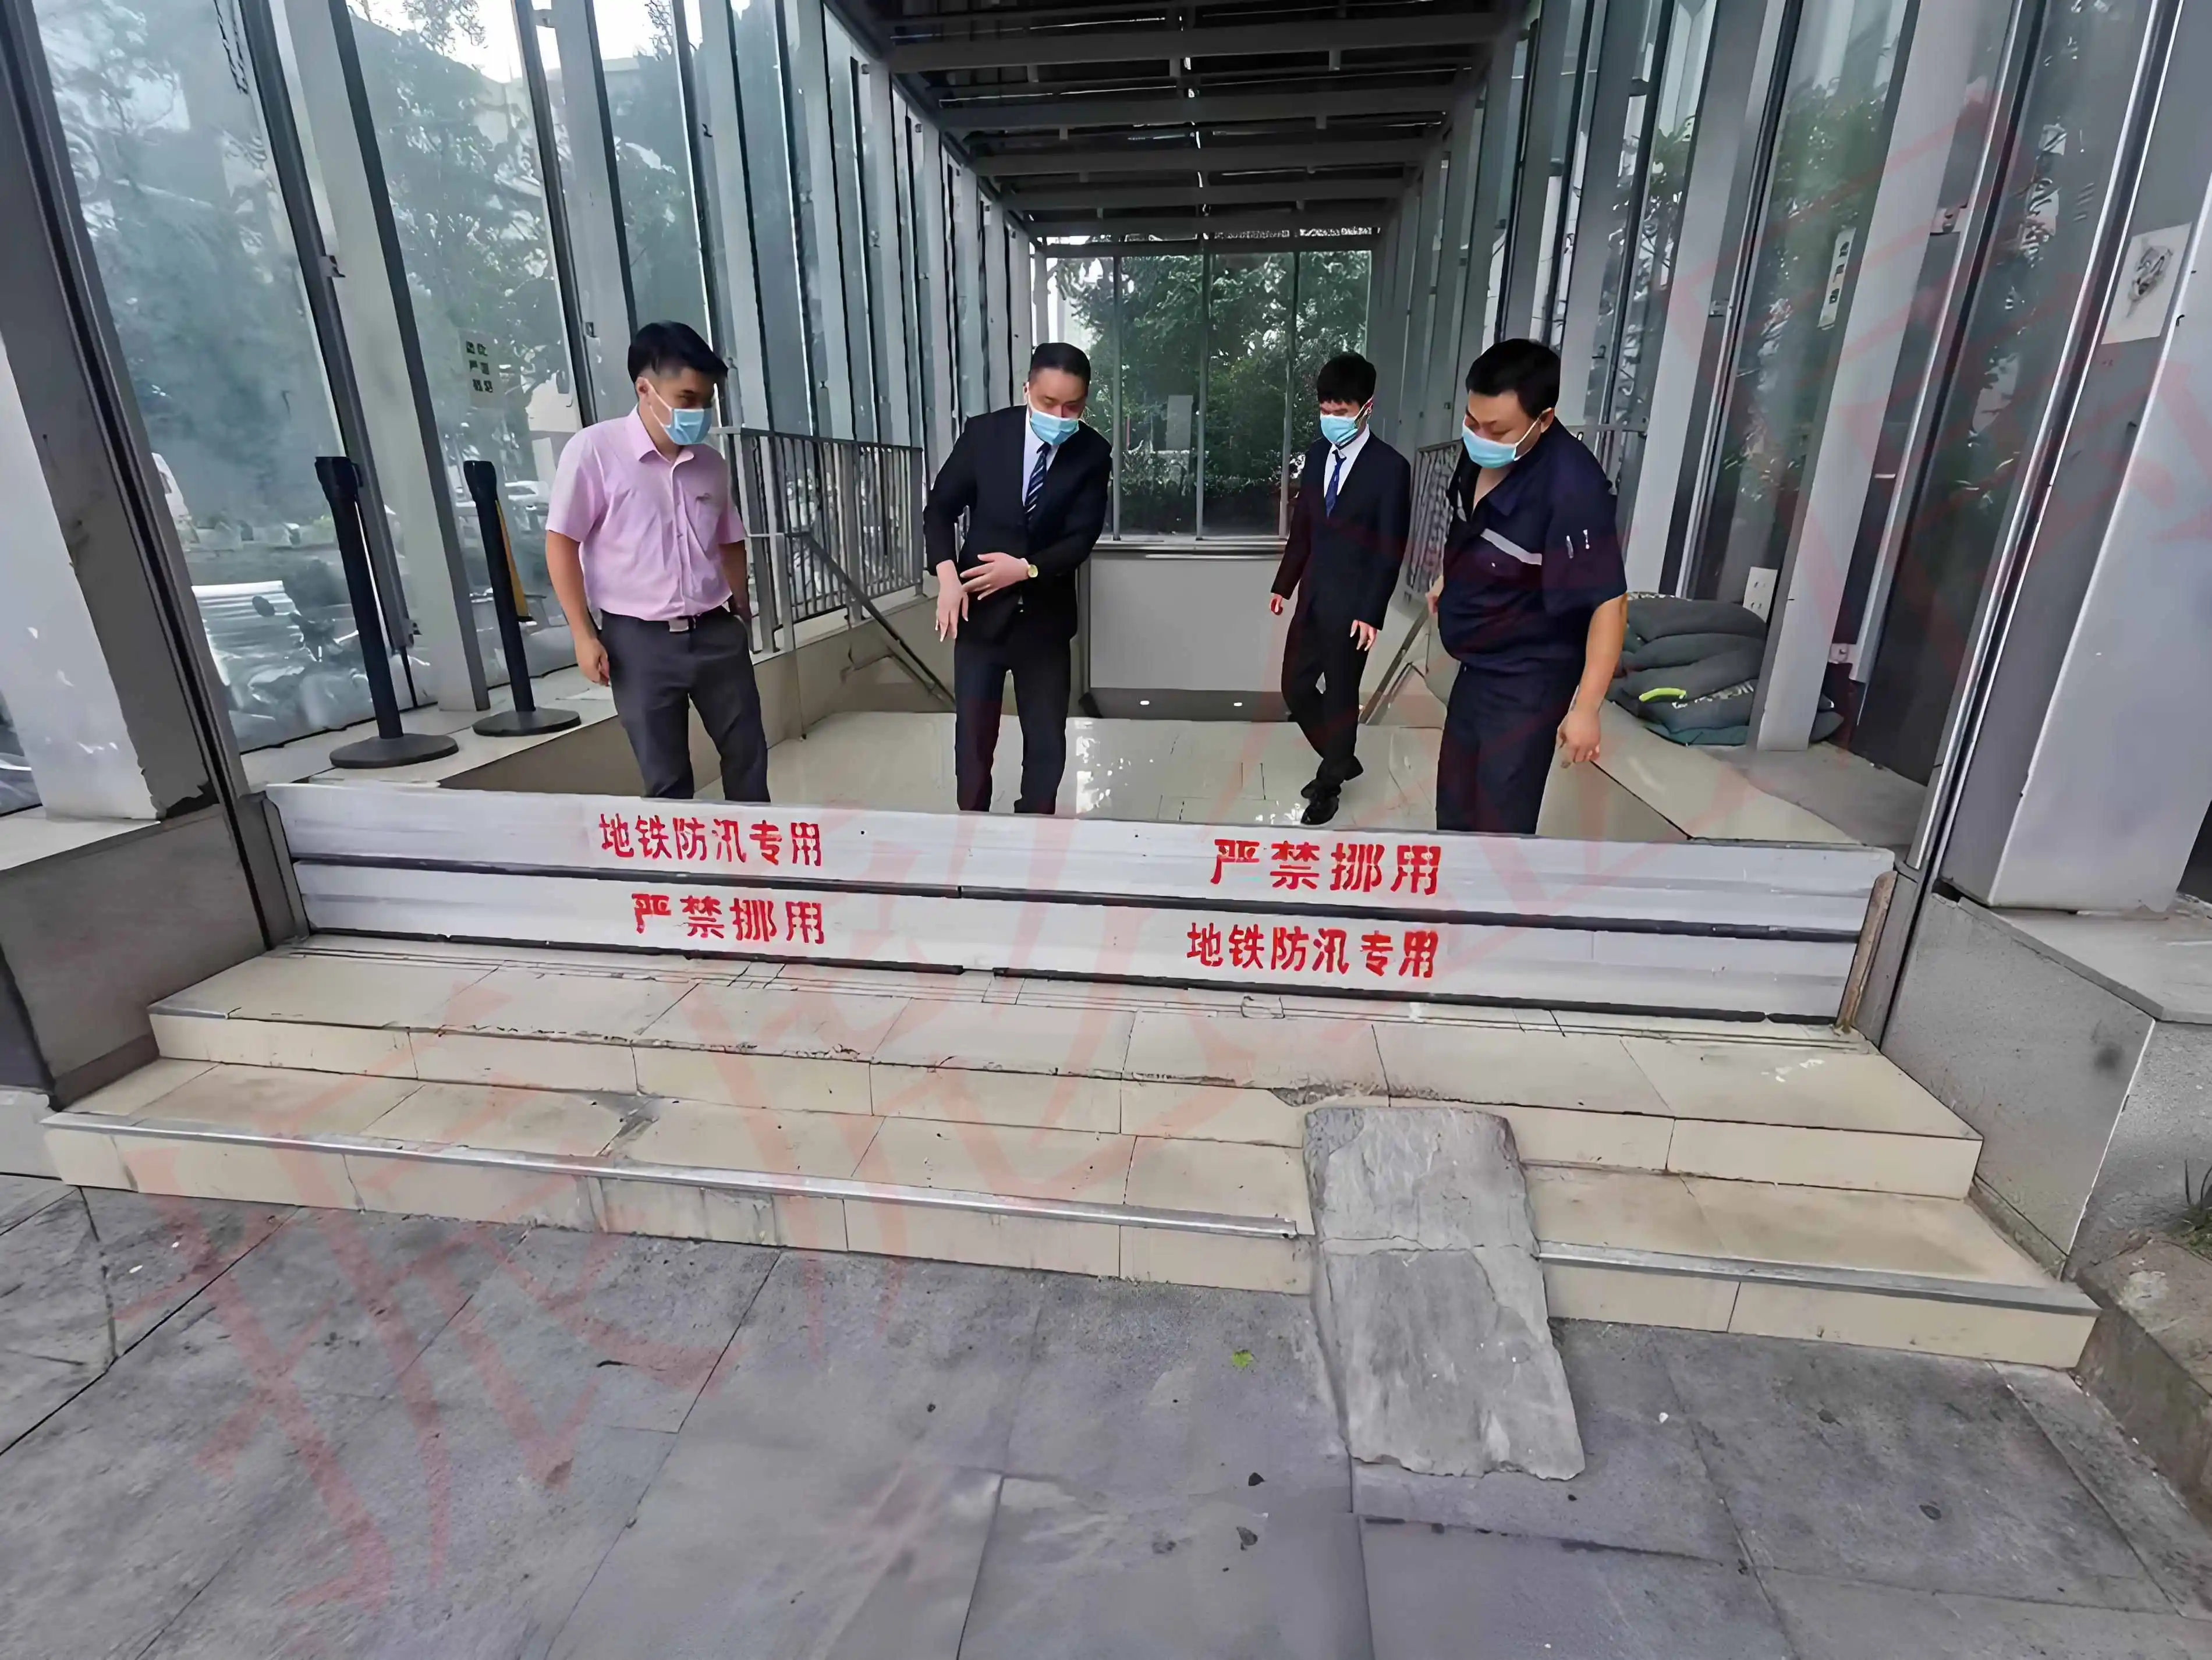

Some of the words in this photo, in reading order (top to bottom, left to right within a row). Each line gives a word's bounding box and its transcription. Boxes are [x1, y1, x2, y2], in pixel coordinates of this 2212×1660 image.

[599, 814, 822, 866] 地铁防汛专用
[1210, 838, 1441, 895] 严禁挪用
[632, 893, 825, 944] 严禁挪用
[1186, 923, 1438, 978] 地铁防汛专用
